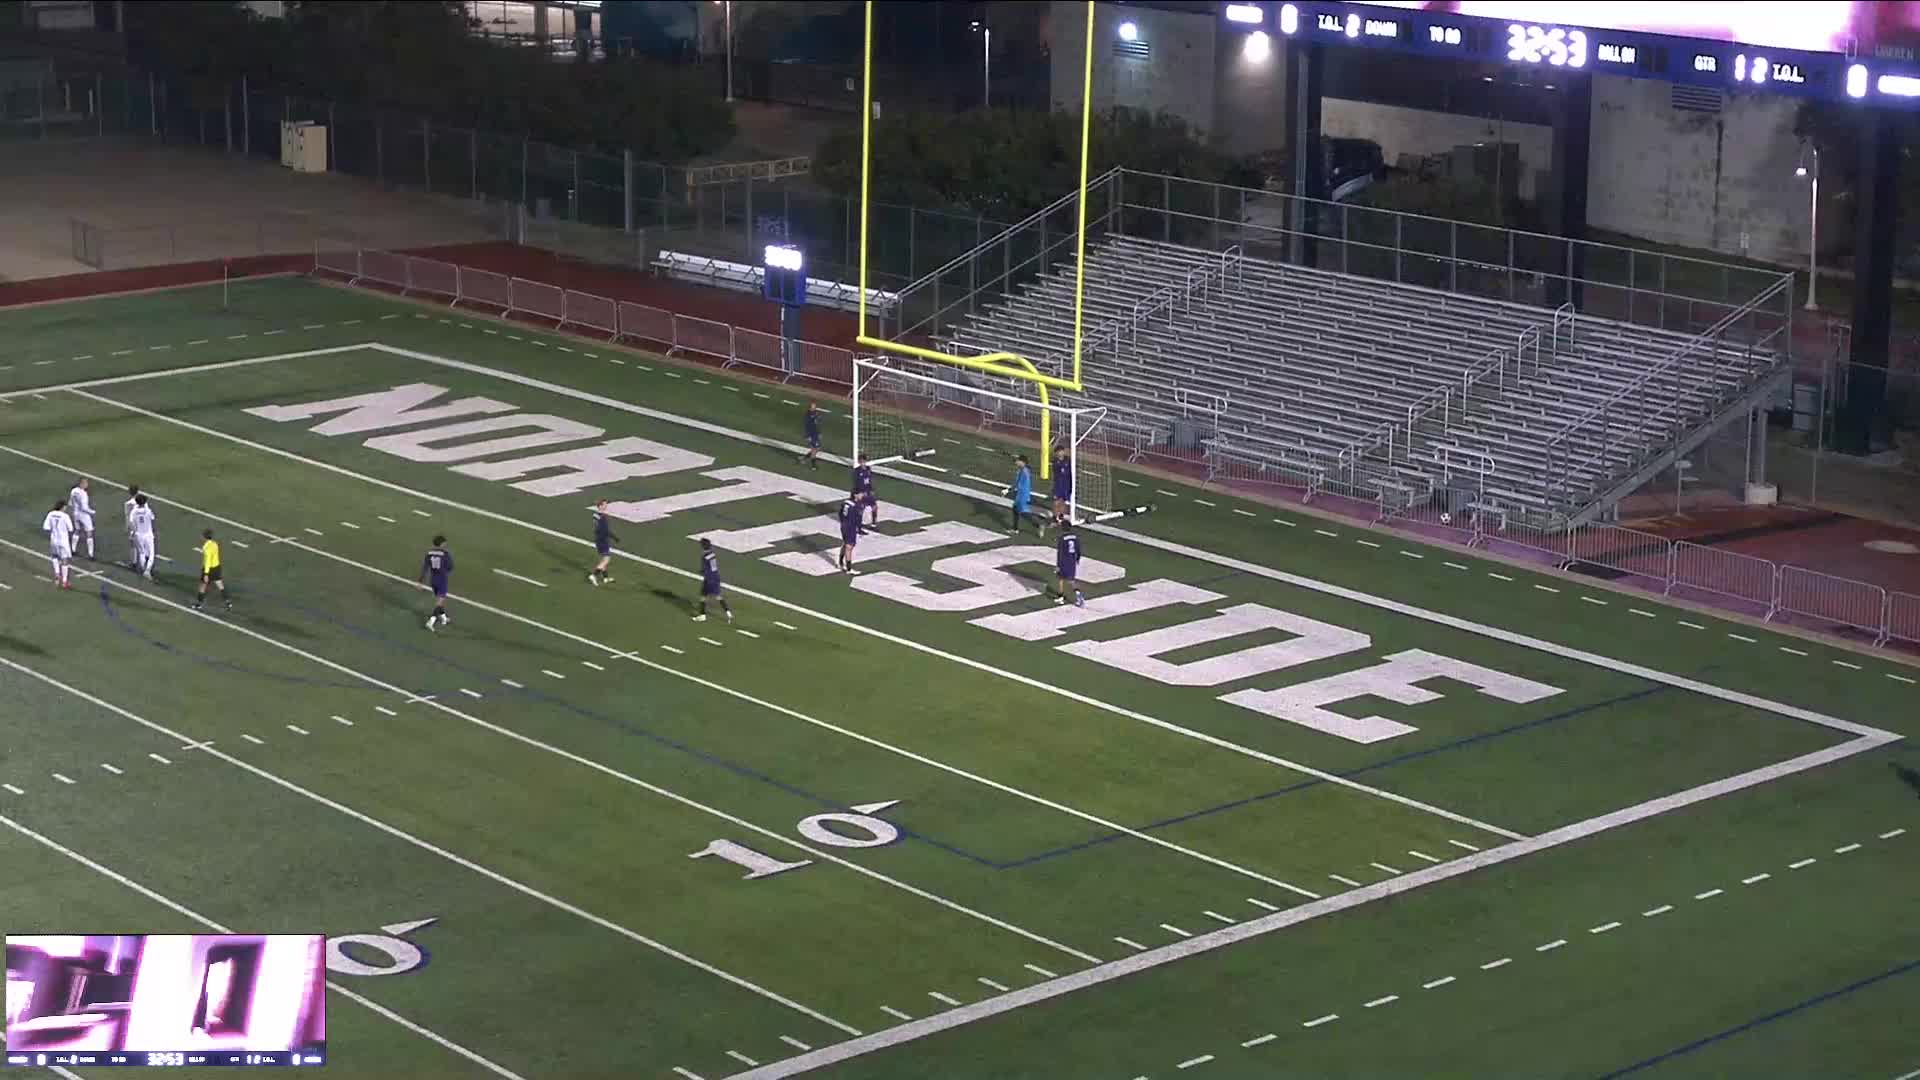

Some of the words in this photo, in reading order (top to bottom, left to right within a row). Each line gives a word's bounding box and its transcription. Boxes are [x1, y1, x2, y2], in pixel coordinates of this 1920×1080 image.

[1365, 19, 1397, 37] DOWN
[1429, 26, 1444, 42] TO
[1507, 23, 1588, 68] 32:53
[248, 382, 1567, 745] NORTHSIDE
